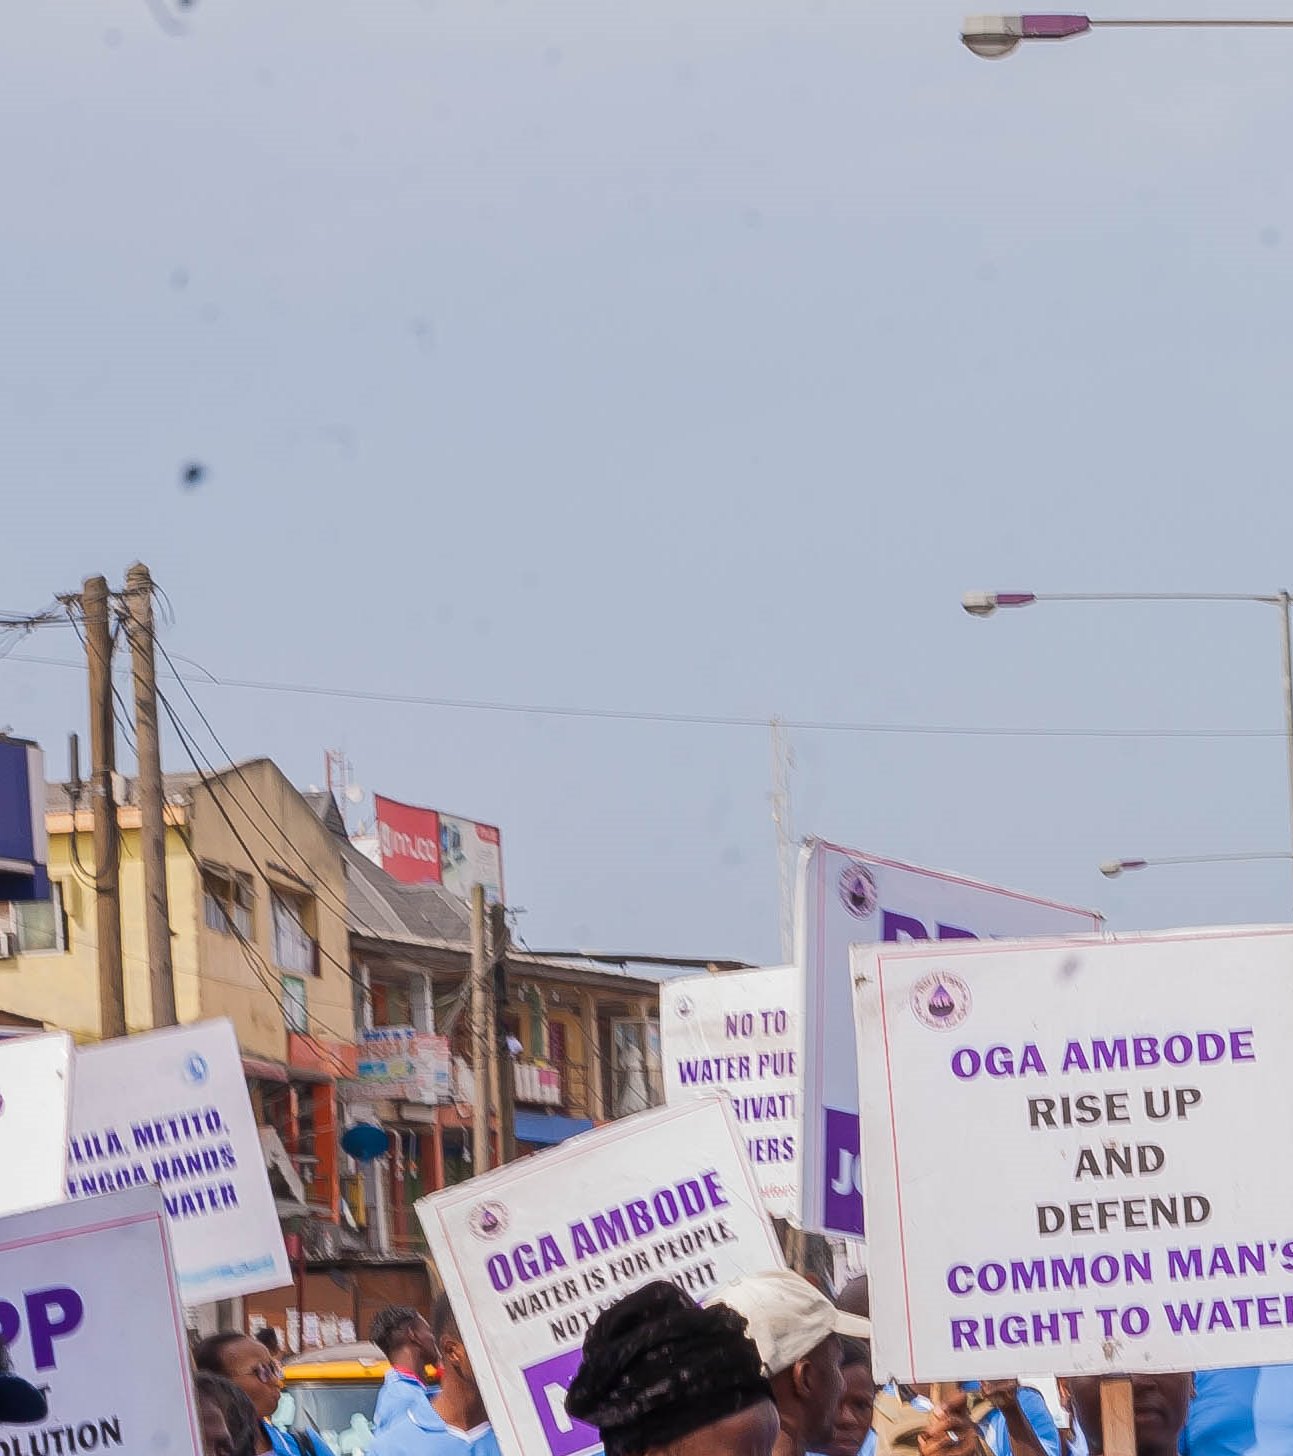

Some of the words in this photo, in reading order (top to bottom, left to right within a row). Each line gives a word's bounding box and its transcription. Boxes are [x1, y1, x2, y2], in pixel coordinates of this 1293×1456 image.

[725, 1013, 753, 1037] NO
[761, 1010, 787, 1034] TO
[678, 1056, 749, 1084] WATER
[951, 1042, 1047, 1078] OGA
[1062, 1028, 1256, 1072] AMBODE
[131, 1108, 231, 1152] METITO,
[1027, 1092, 1131, 1130] RISE
[1143, 1087, 1202, 1120] UP
[152, 1144, 238, 1184] HANDS
[1075, 1143, 1165, 1180] AND
[486, 1234, 567, 1292] OGA
[567, 1171, 728, 1261] AMBODE
[1036, 1195, 1212, 1235] DEFEND
[503, 1277, 580, 1323] WATER
[583, 1269, 606, 1295] IS
[608, 1255, 652, 1285] FOR
[655, 1221, 739, 1264] PEOPLE,
[946, 1250, 1153, 1294] COMMON
[549, 1308, 599, 1344] NOT
[950, 1309, 1083, 1350] RIGHT
[1095, 1305, 1150, 1338] TO
